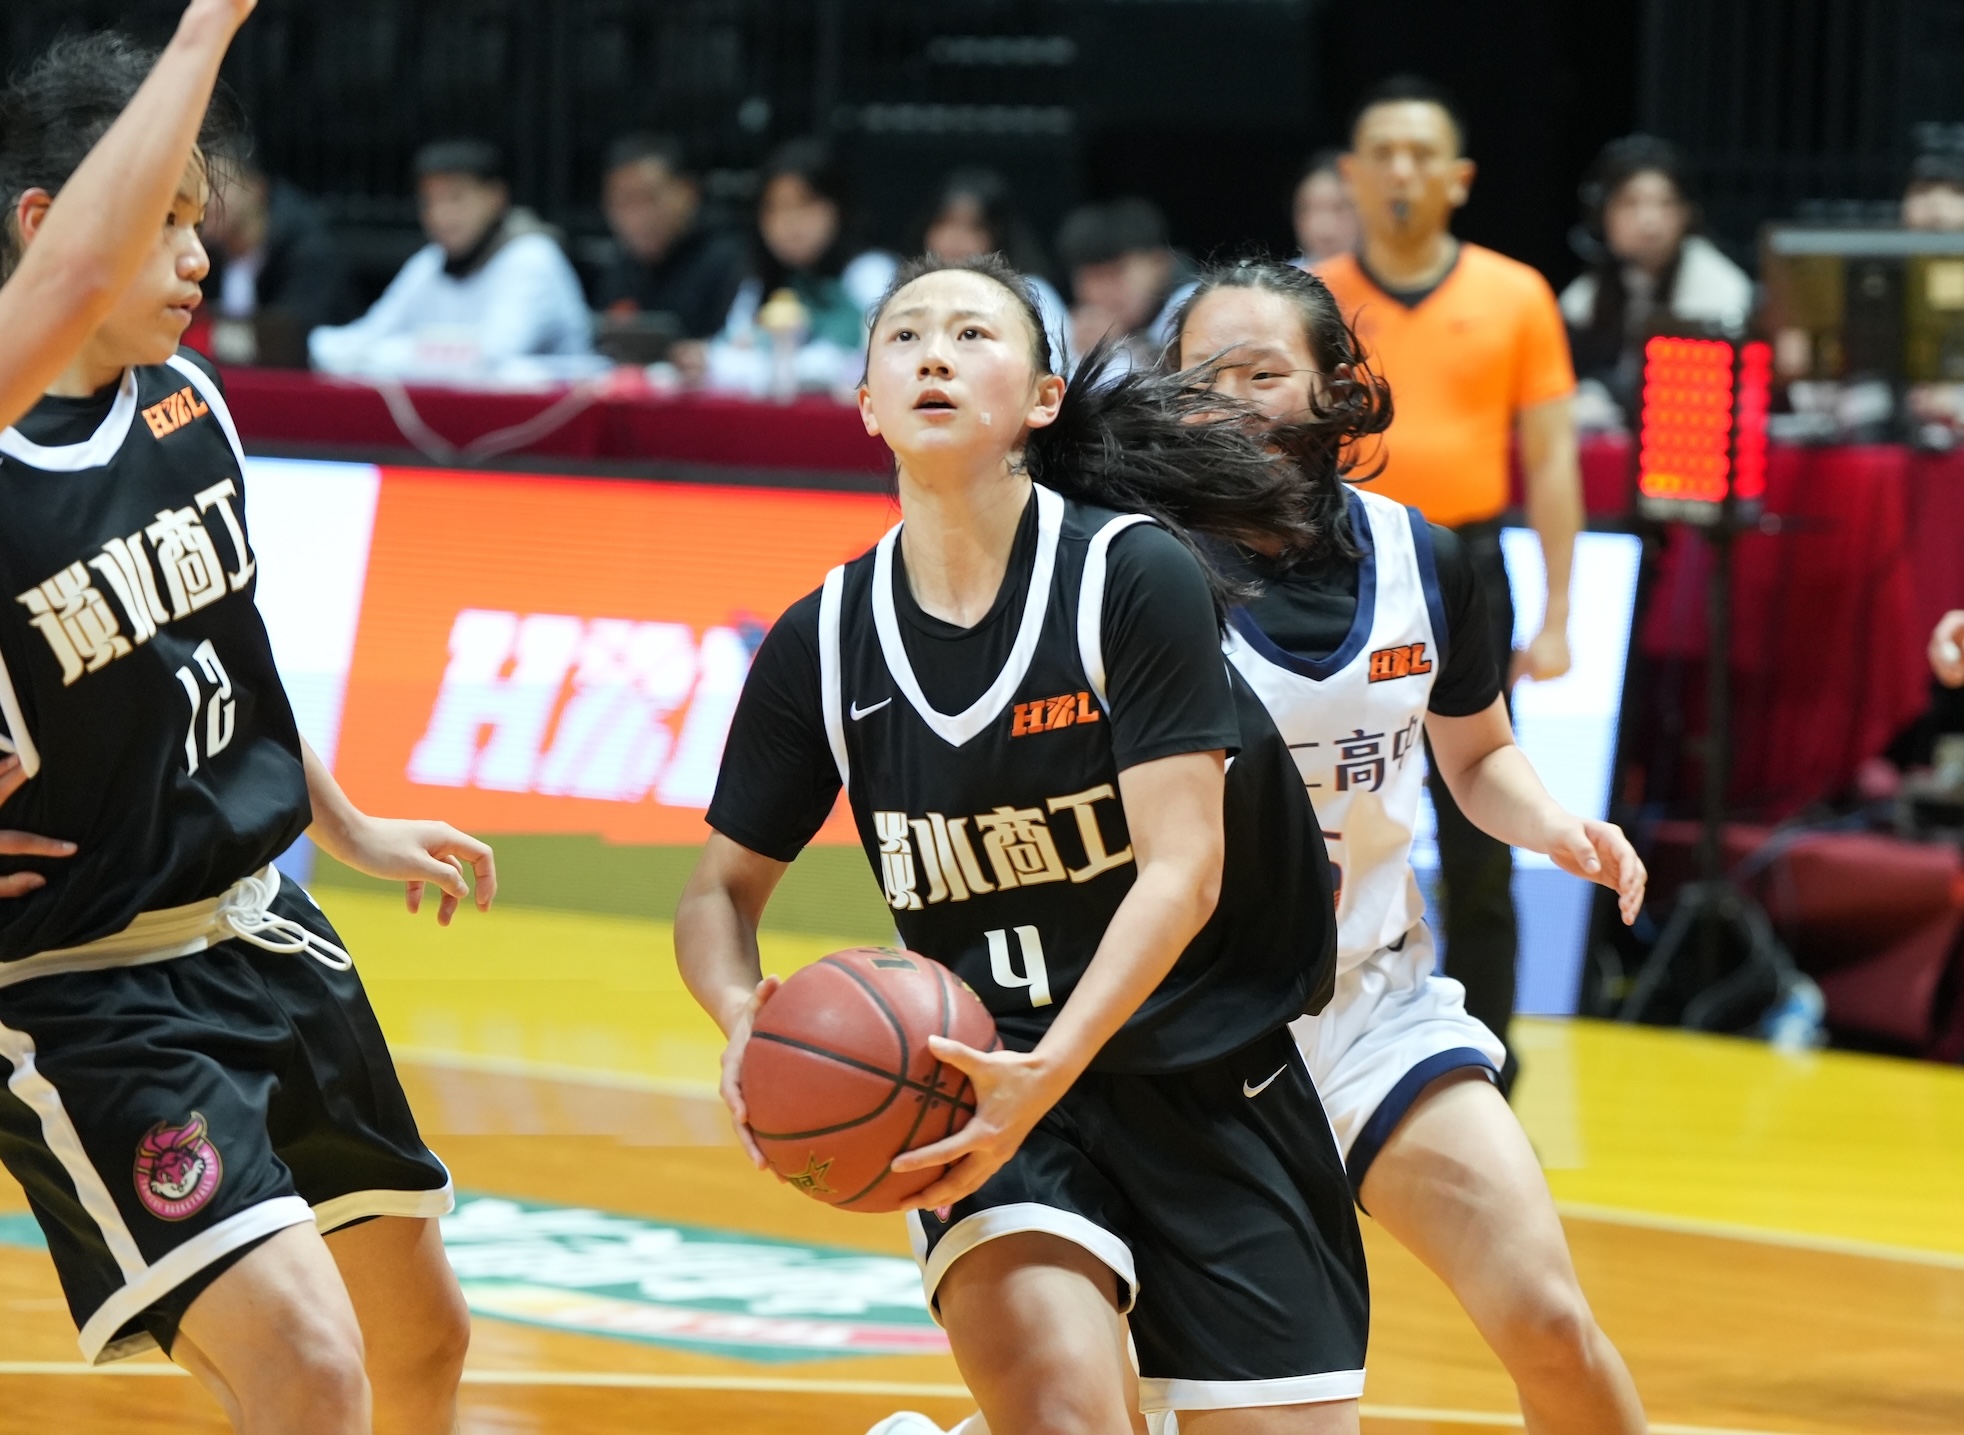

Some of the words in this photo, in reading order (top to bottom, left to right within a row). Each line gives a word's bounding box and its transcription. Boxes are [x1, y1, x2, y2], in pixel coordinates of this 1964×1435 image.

[141, 386, 208, 439] HBL
[16, 477, 256, 687] 淡水商工
[1368, 642, 1432, 684] HBL
[175, 638, 236, 777] 12
[1010, 691, 1100, 737] HBL
[873, 784, 1134, 911] 淡水商工
[983, 924, 1053, 1008] 4
